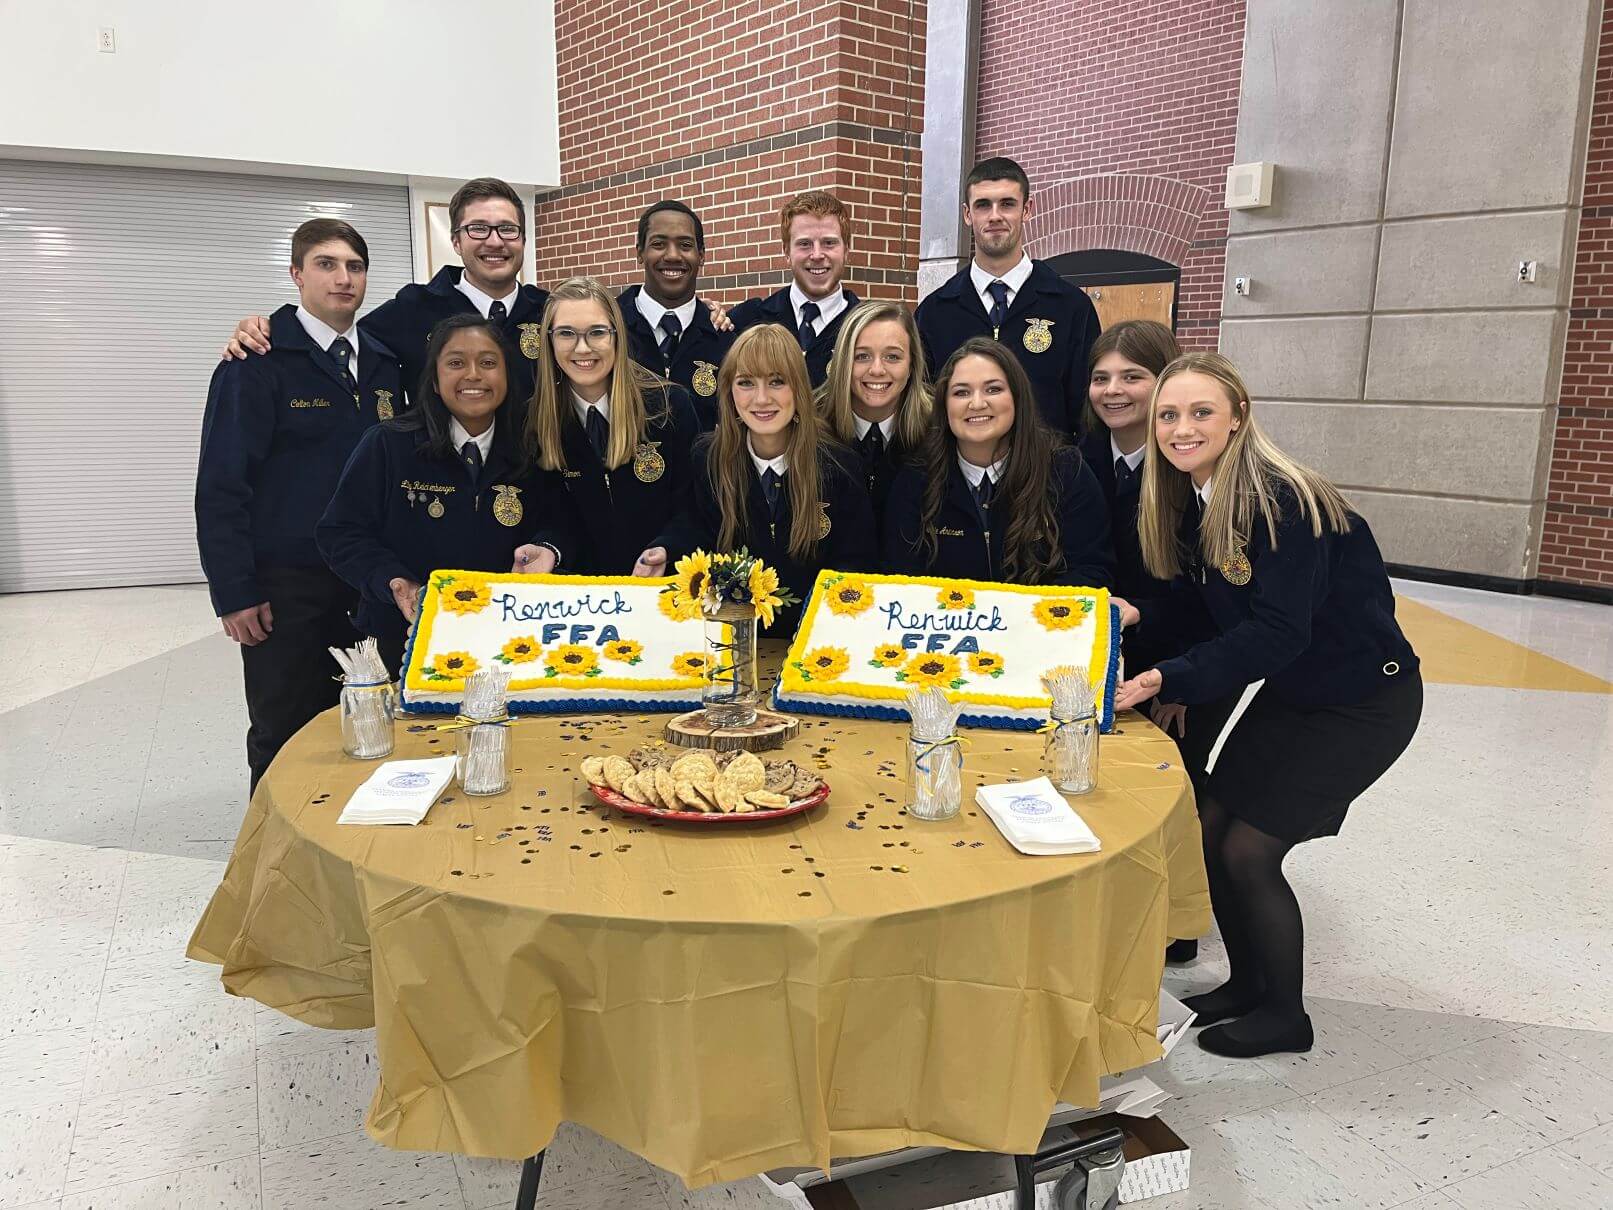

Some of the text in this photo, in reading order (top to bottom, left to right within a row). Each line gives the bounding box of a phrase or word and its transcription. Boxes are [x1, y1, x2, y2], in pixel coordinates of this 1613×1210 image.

[492, 591, 633, 622] Renwick
[879, 600, 1008, 632] Renwick
[541, 623, 621, 646] FFA
[901, 633, 979, 655] FFA
